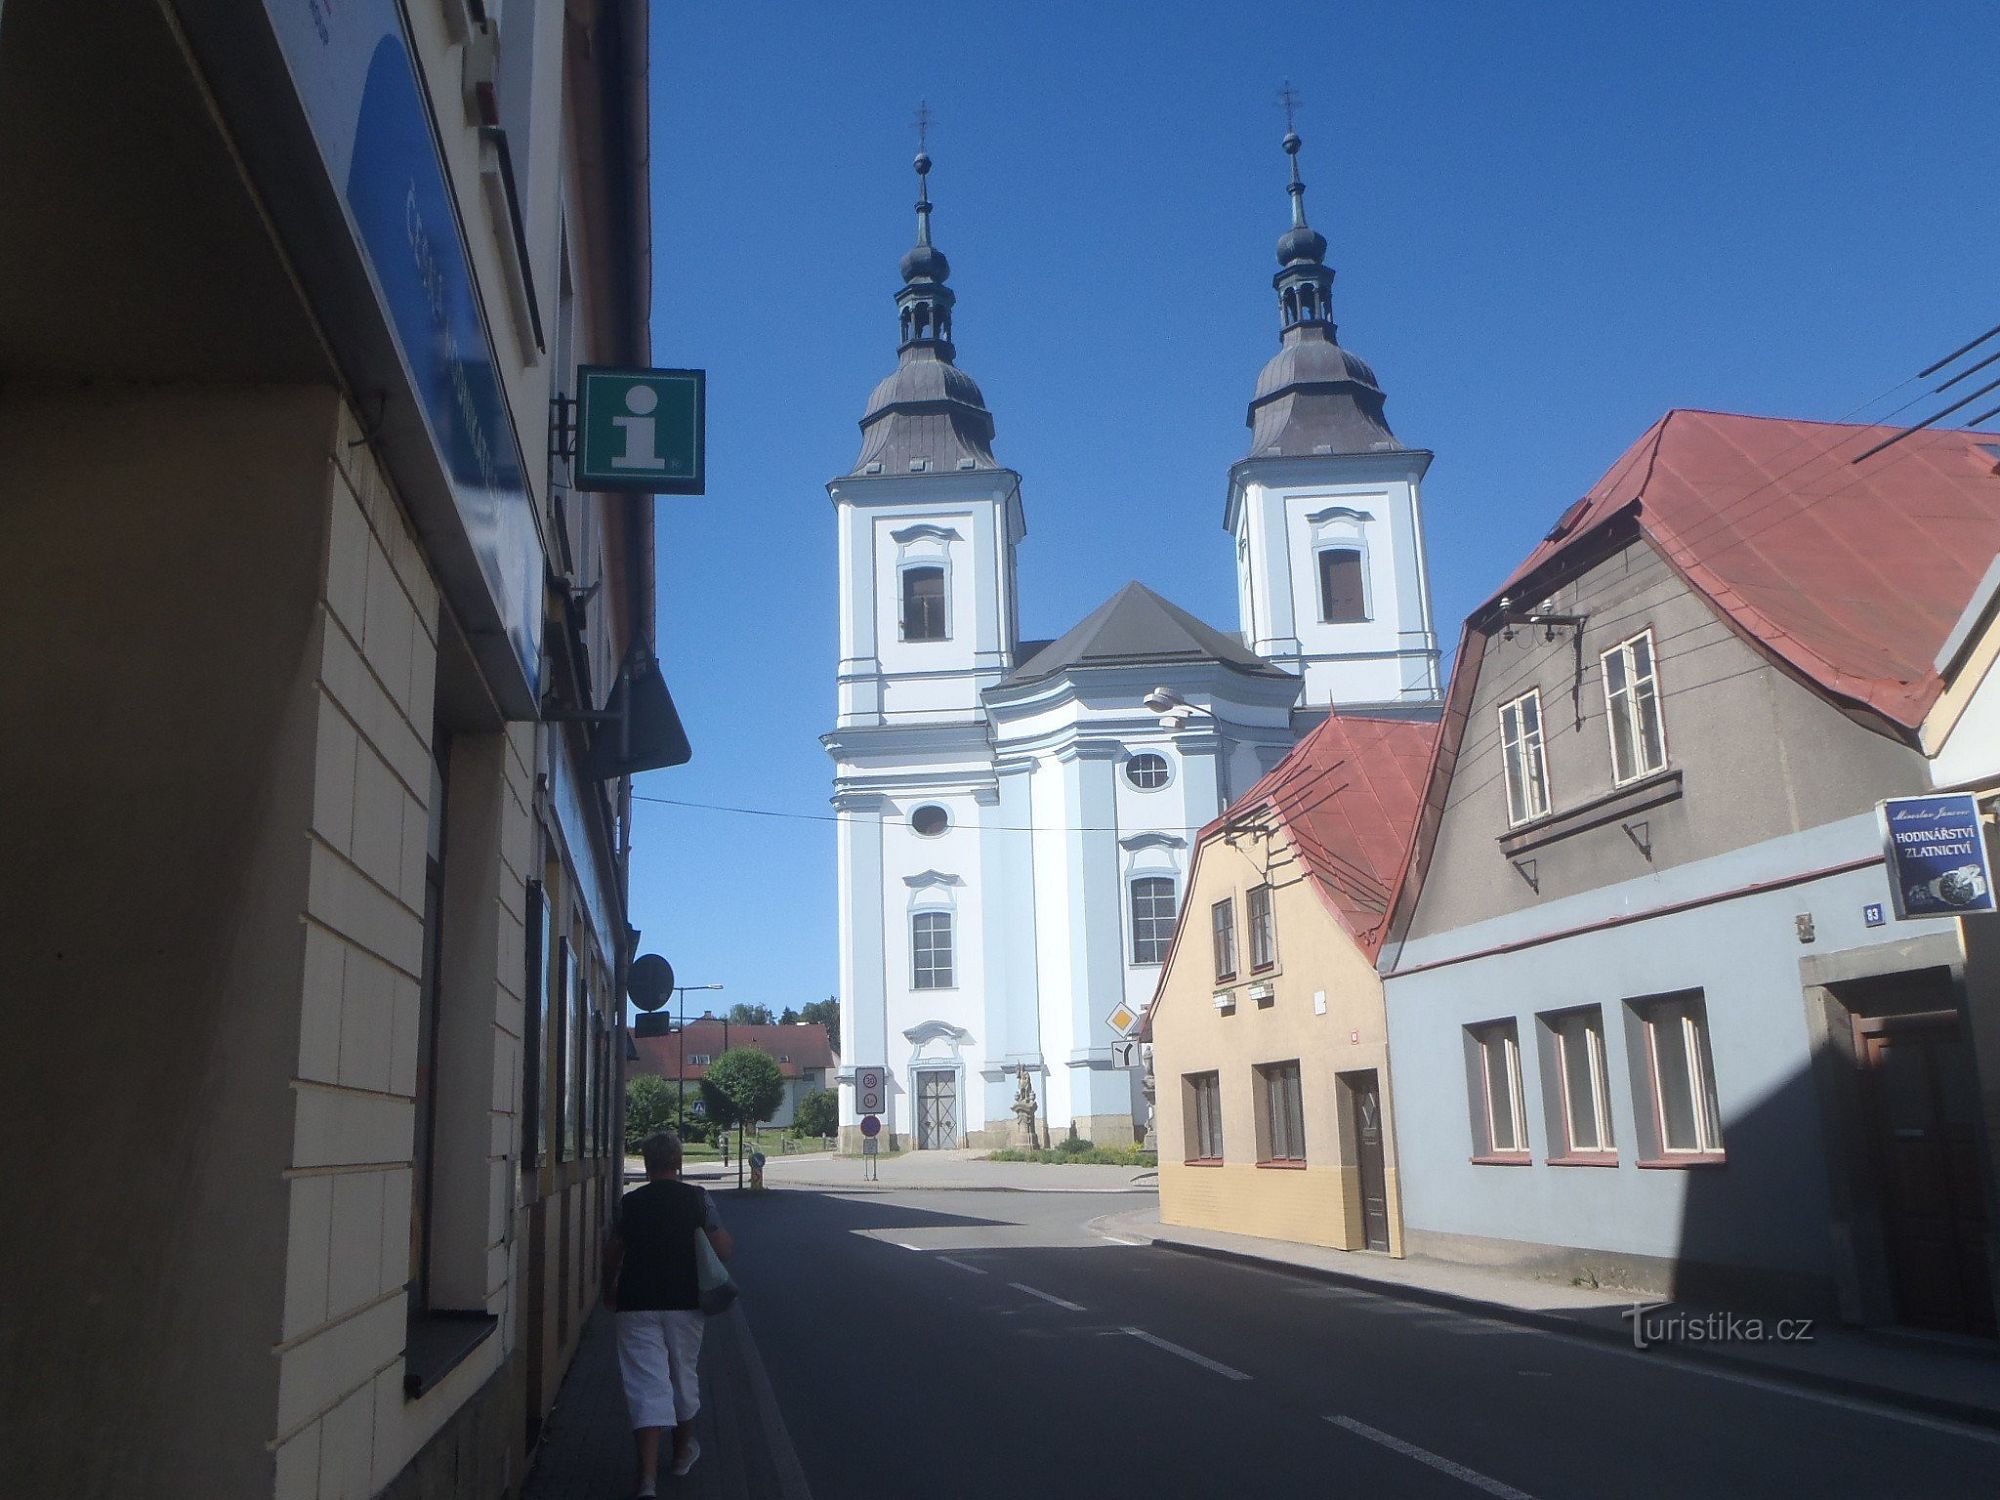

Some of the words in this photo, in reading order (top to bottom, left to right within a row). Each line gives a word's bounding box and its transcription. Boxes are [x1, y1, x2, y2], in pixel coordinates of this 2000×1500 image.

[1895, 825, 1975, 843] HODINÁŘSTVÍ
[1904, 841, 1972, 858] ZLATNICTVÍ
[1867, 908, 1879, 921] 83
